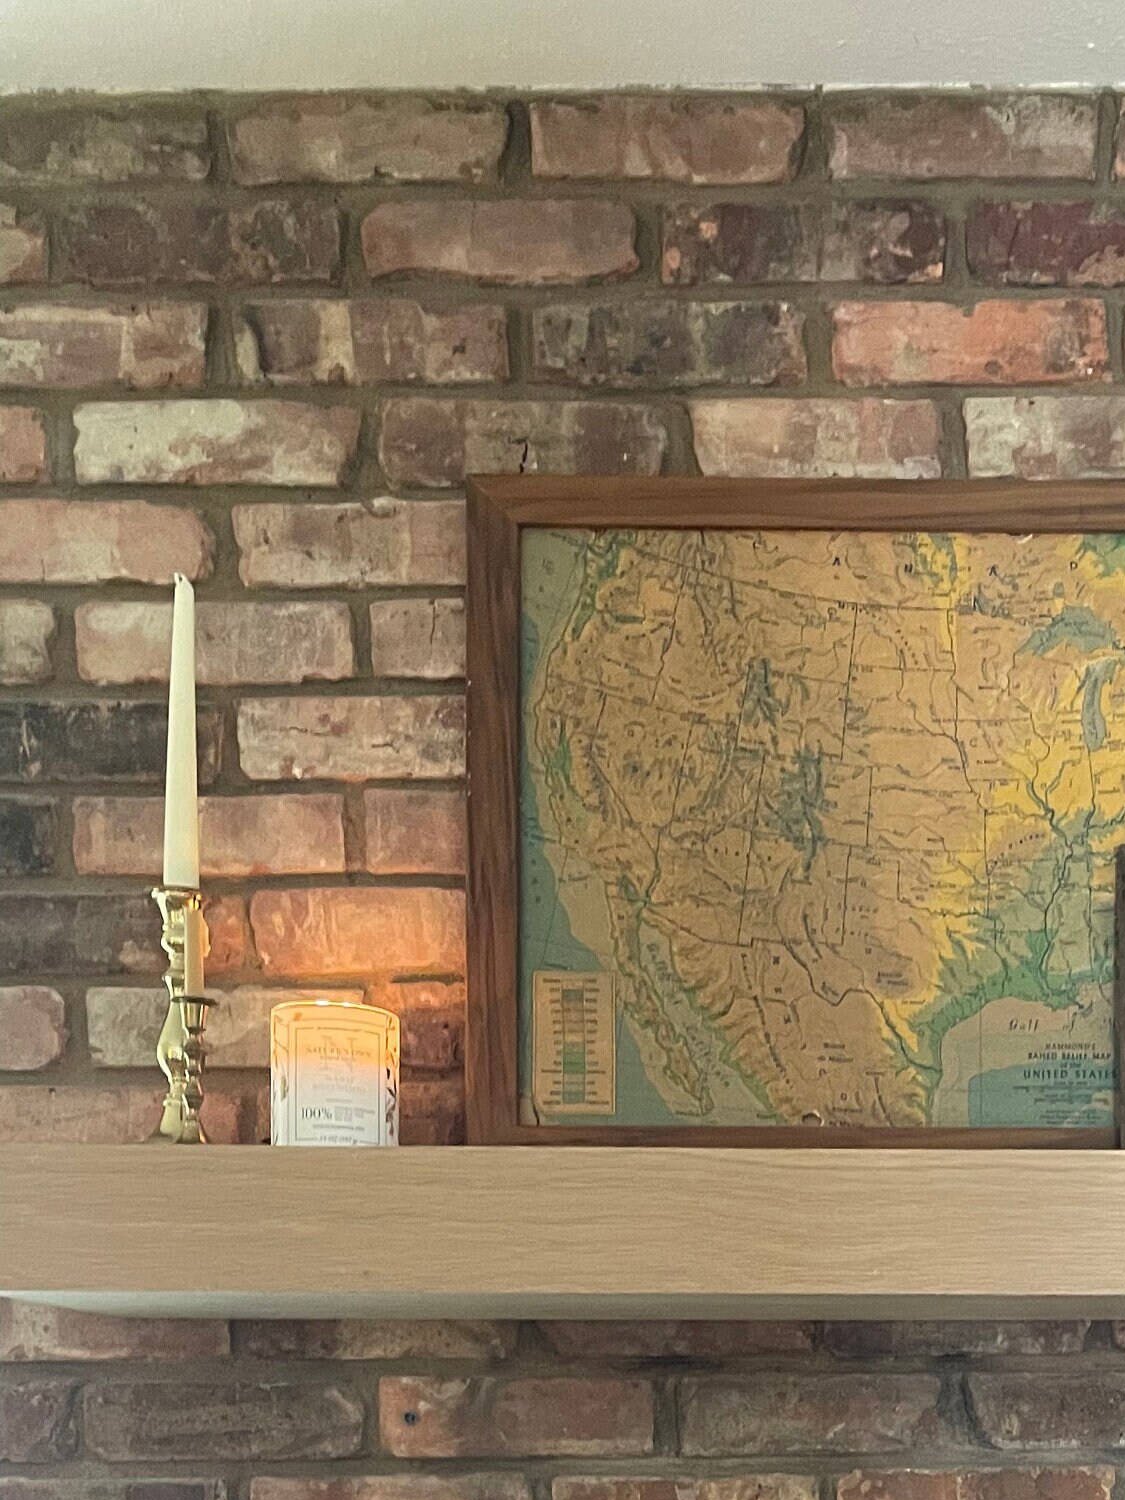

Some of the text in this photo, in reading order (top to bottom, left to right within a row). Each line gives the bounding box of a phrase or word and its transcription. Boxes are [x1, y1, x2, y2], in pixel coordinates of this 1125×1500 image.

[1027, 1052, 1111, 1060] RAISED RELIEF MAP
[1023, 1069, 1069, 1080] UNITED
[301, 1107, 332, 1120] 100%
